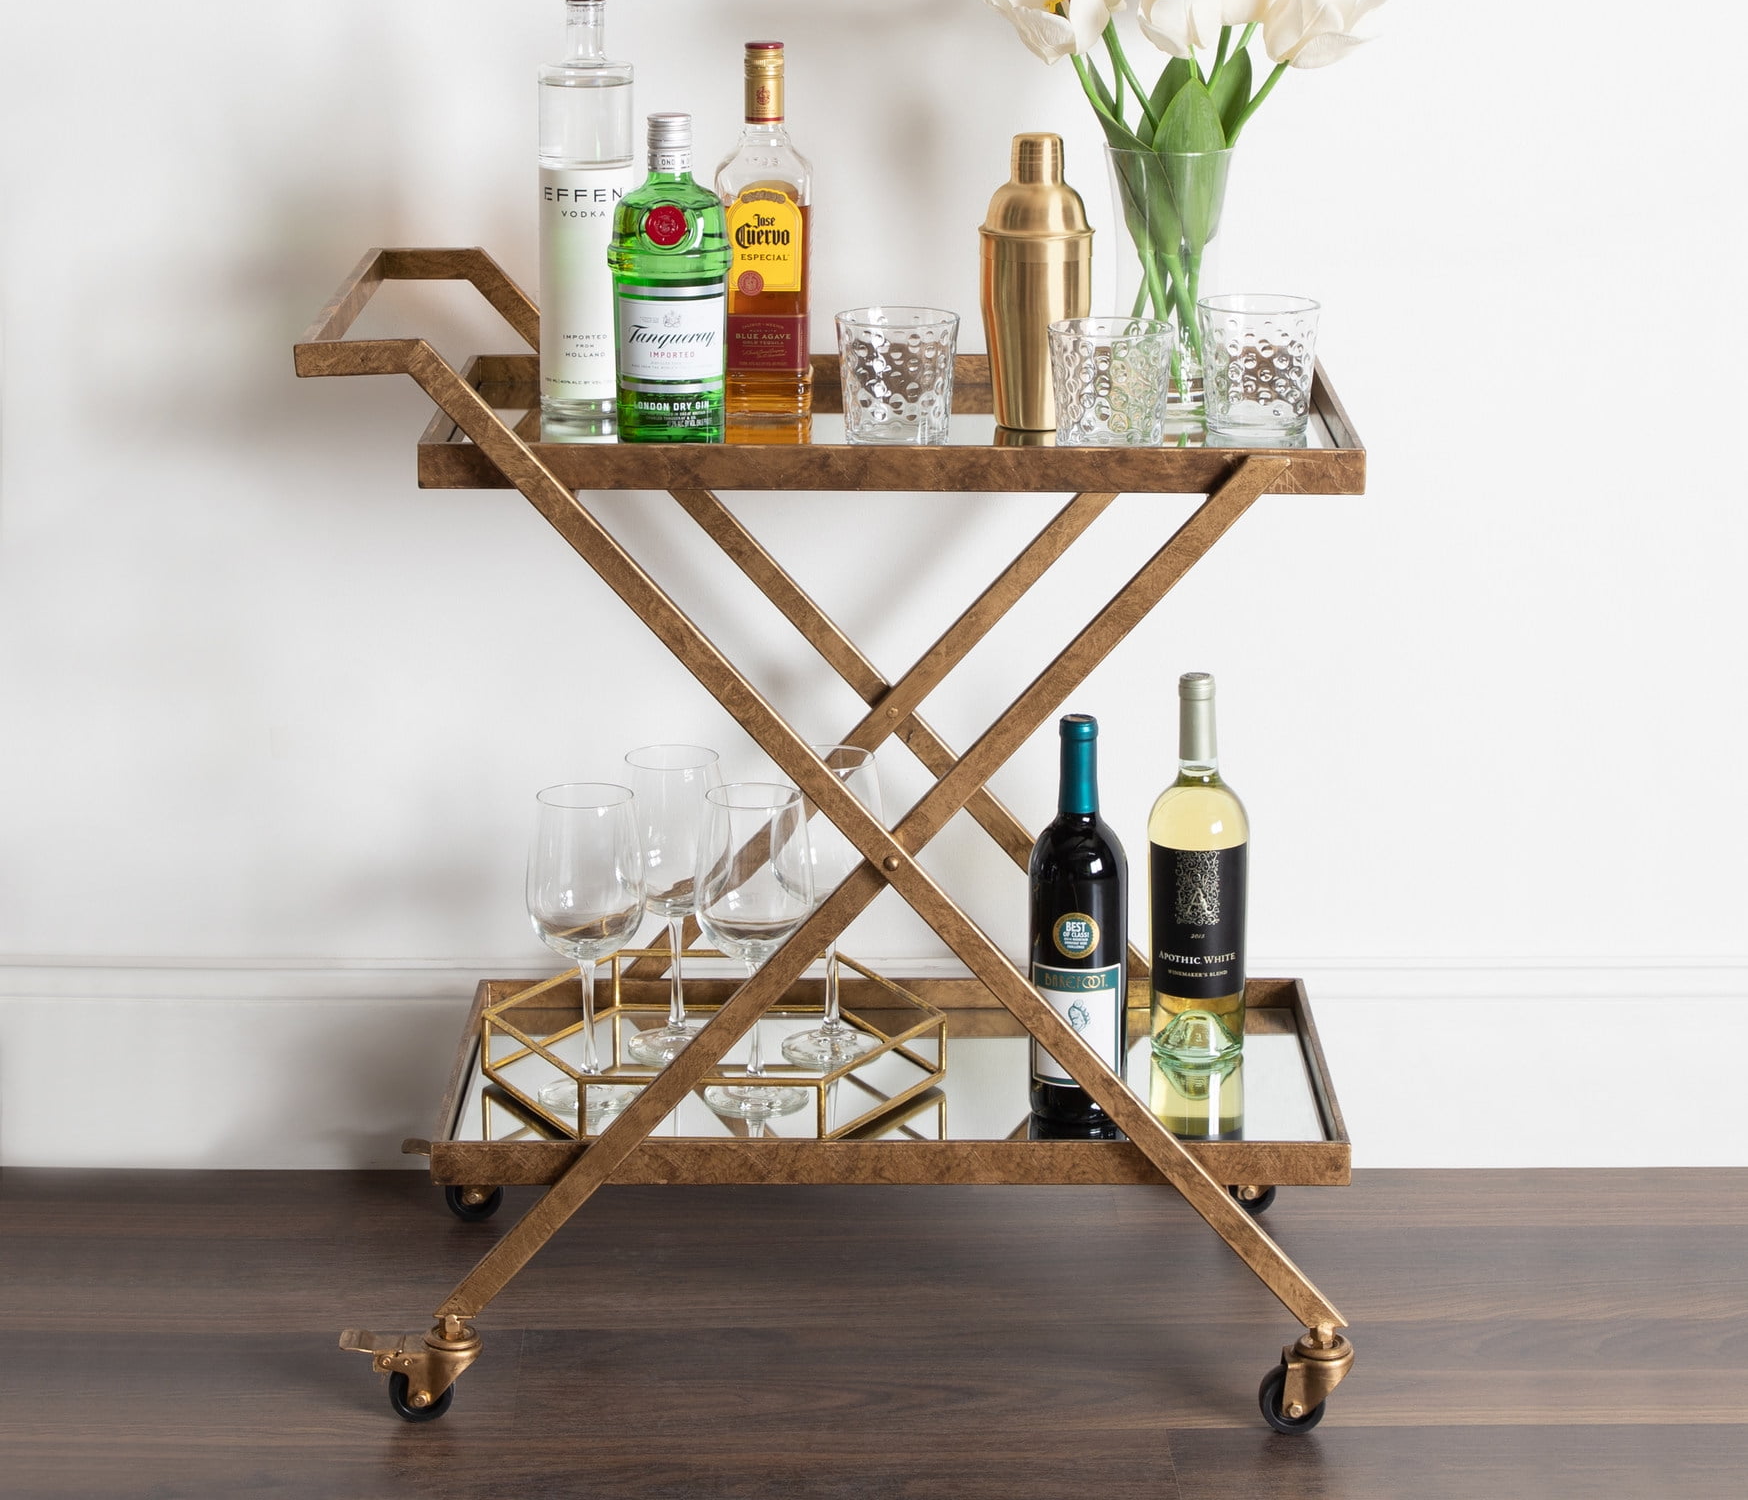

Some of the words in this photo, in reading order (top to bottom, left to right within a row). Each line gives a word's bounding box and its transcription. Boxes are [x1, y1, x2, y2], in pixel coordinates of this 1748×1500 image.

[544, 186, 624, 203] EFFEN
[561, 210, 606, 218] VODKA
[752, 213, 776, 228] Jose
[735, 222, 790, 249] Cuervo
[741, 253, 788, 261] ESPECIAL
[628, 324, 715, 349] Tanqueray
[649, 351, 695, 359] IMPORTED
[634, 401, 670, 412] LONDON
[673, 401, 692, 411] DRY
[695, 400, 710, 409] GIN
[1065, 921, 1087, 933] BEST
[1158, 949, 1201, 965] APOTHIC
[1203, 951, 1237, 965] WHITE
[1209, 969, 1228, 977] BLEND
